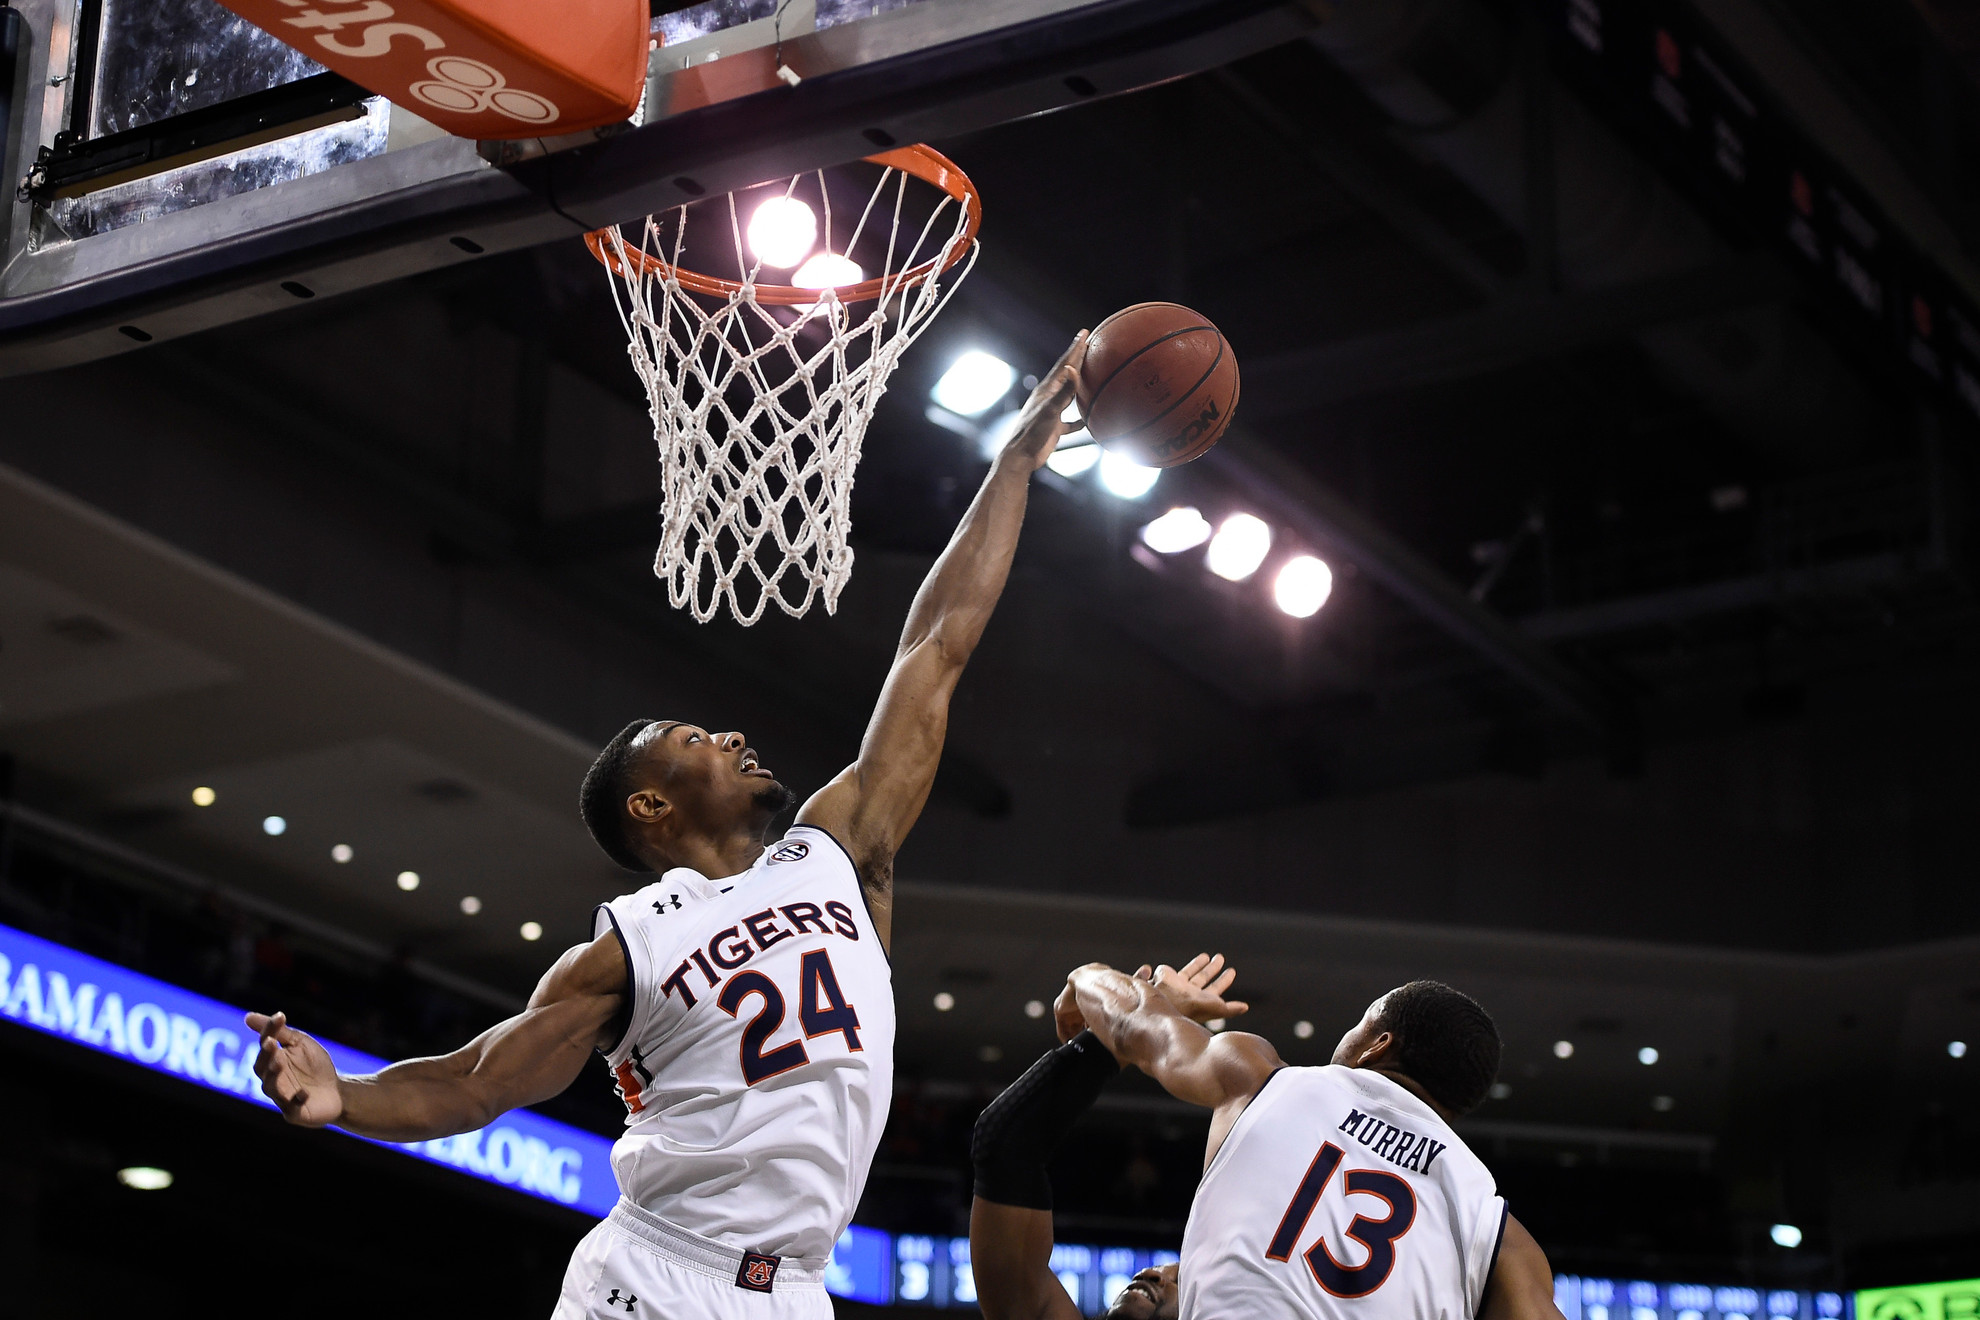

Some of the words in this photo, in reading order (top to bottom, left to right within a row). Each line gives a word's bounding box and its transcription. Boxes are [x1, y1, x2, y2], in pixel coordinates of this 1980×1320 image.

[280, 0, 446, 57] St
[660, 901, 859, 1011] TIGERS
[716, 948, 864, 1087] 24
[1338, 1108, 1447, 1176] MURRAY
[1265, 1140, 1418, 1299] 13
